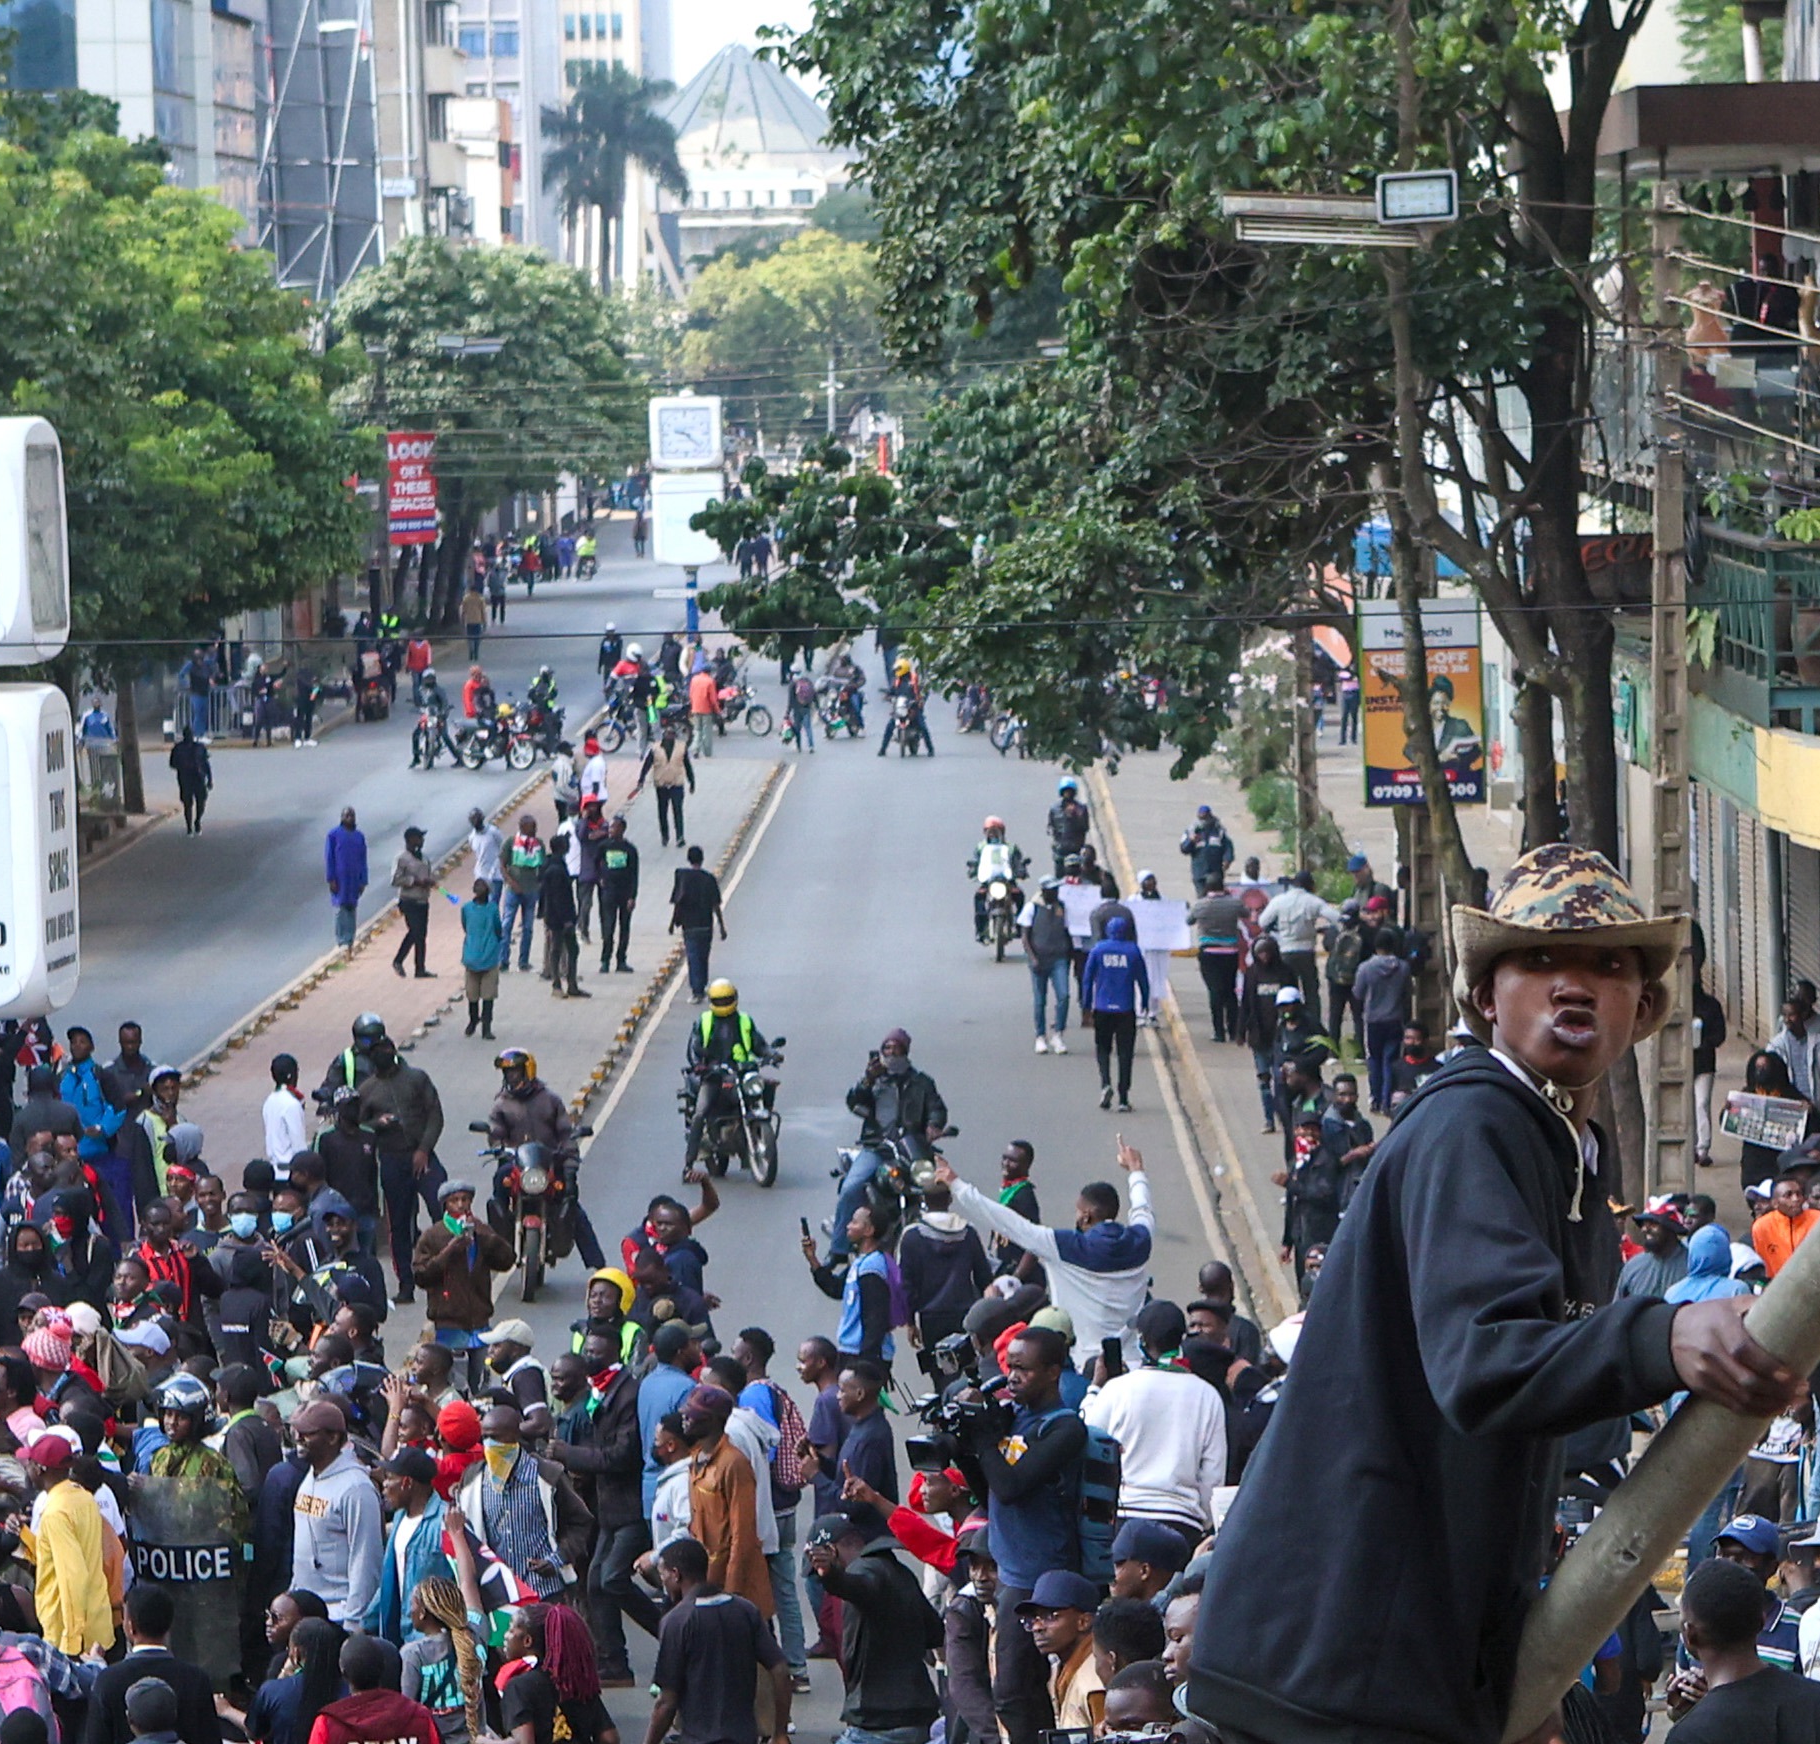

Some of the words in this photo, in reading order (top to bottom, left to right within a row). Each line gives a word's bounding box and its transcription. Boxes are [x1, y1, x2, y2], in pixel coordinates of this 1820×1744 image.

[387, 441, 435, 461] LOOK
[400, 464, 424, 480] GET
[393, 481, 431, 496] THESE
[46, 728, 65, 773] BOOK
[1102, 954, 1128, 968] USA
[137, 1547, 231, 1580] POLICE
